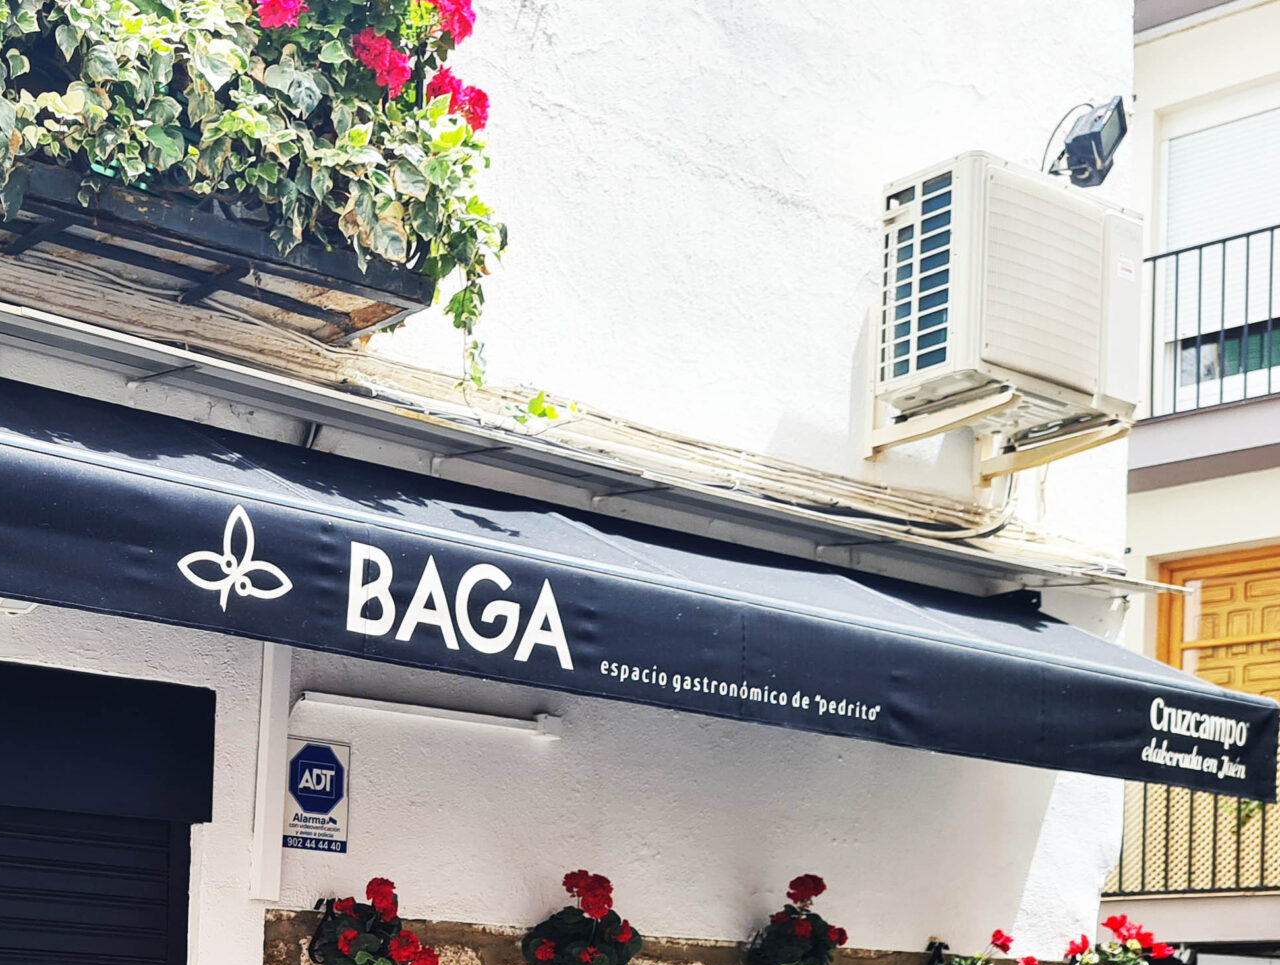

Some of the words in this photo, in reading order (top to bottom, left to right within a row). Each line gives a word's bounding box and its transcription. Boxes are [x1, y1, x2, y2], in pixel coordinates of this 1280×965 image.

[346, 541, 574, 670] BAGA
[600, 660, 668, 684] espacio
[672, 673, 787, 706] gastronómico
[792, 691, 810, 709] de
[1141, 737, 1203, 771] elaborada
[1203, 757, 1218, 774] en
[1217, 755, 1246, 779] Jaén
[298, 767, 336, 792] ADT
[292, 812, 326, 825] Alarma
[287, 837, 303, 847] 902
[305, 839, 316, 849] 44
[318, 841, 329, 850] 44
[330, 842, 341, 851] 40
